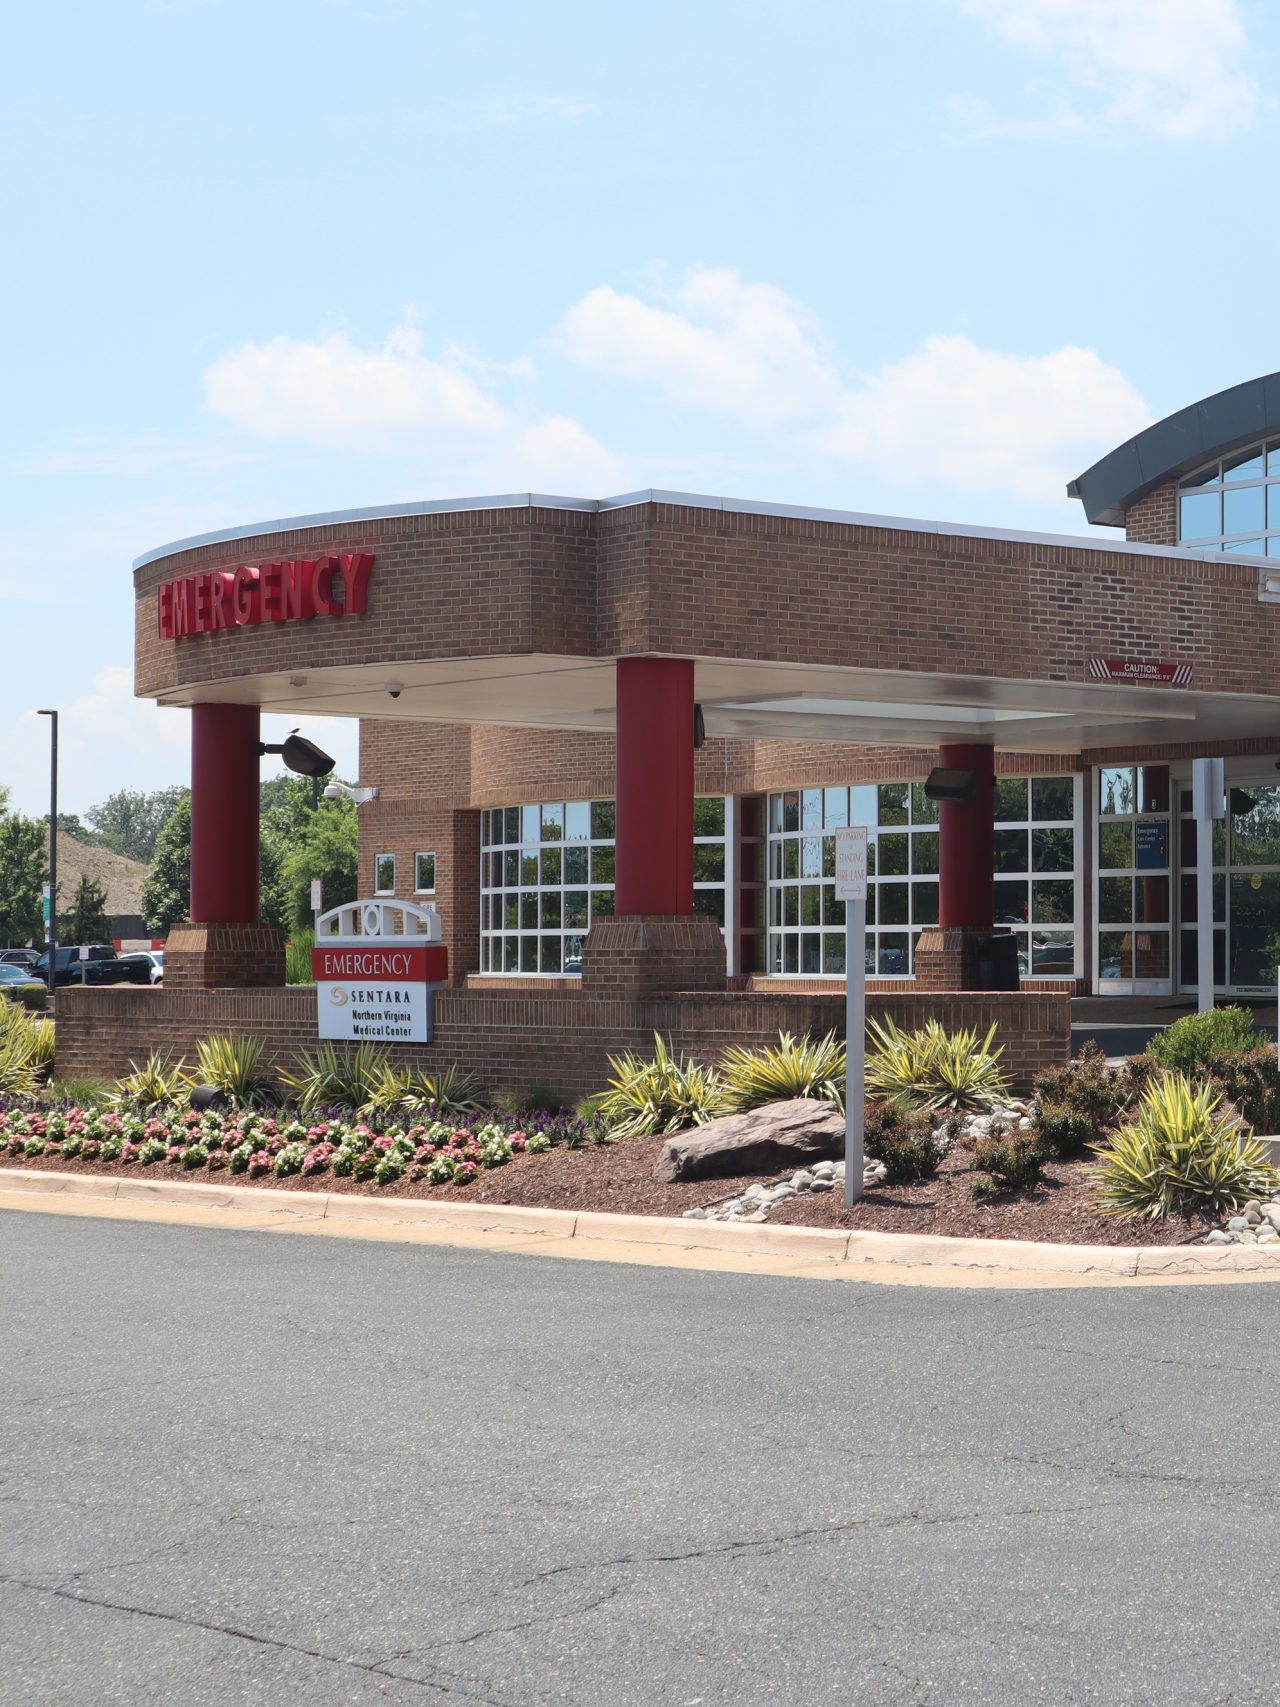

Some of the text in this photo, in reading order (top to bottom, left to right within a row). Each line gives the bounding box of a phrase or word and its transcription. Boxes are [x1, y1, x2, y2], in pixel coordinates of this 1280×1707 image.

[159, 554, 374, 640] EMERGENCY
[1124, 663, 1160, 674] CAUTION:
[846, 831, 866, 841] PARKING
[837, 869, 865, 881] FIRE LANE
[324, 954, 412, 975] EMERGENCY
[351, 990, 411, 1003] SENTARA
[352, 1010, 411, 1023] Northern Virginia
[353, 1025, 411, 1037] Medical Center
